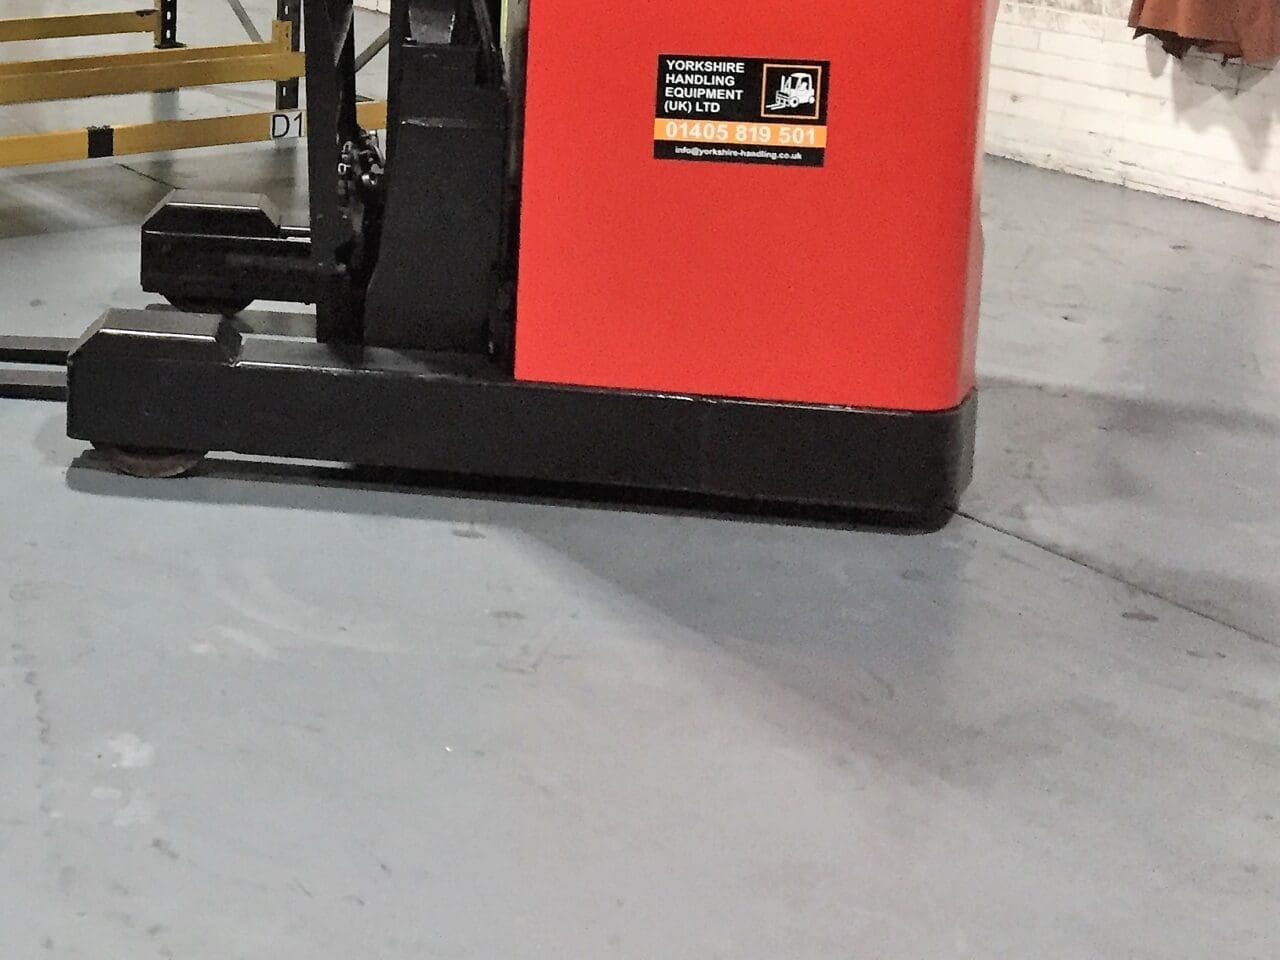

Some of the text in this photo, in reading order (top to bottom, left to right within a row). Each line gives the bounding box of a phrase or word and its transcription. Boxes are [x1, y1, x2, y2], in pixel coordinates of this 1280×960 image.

[666, 59, 745, 73] YORKSHIRE
[665, 74, 735, 87] HANDLING
[665, 87, 744, 100] EQUIPMENT
[664, 100, 720, 114] (UK) LTD
[272, 111, 302, 138] D1
[665, 121, 815, 145] 01405 819 501
[675, 146, 802, 160] info@yorkshire-handling.co.uk
